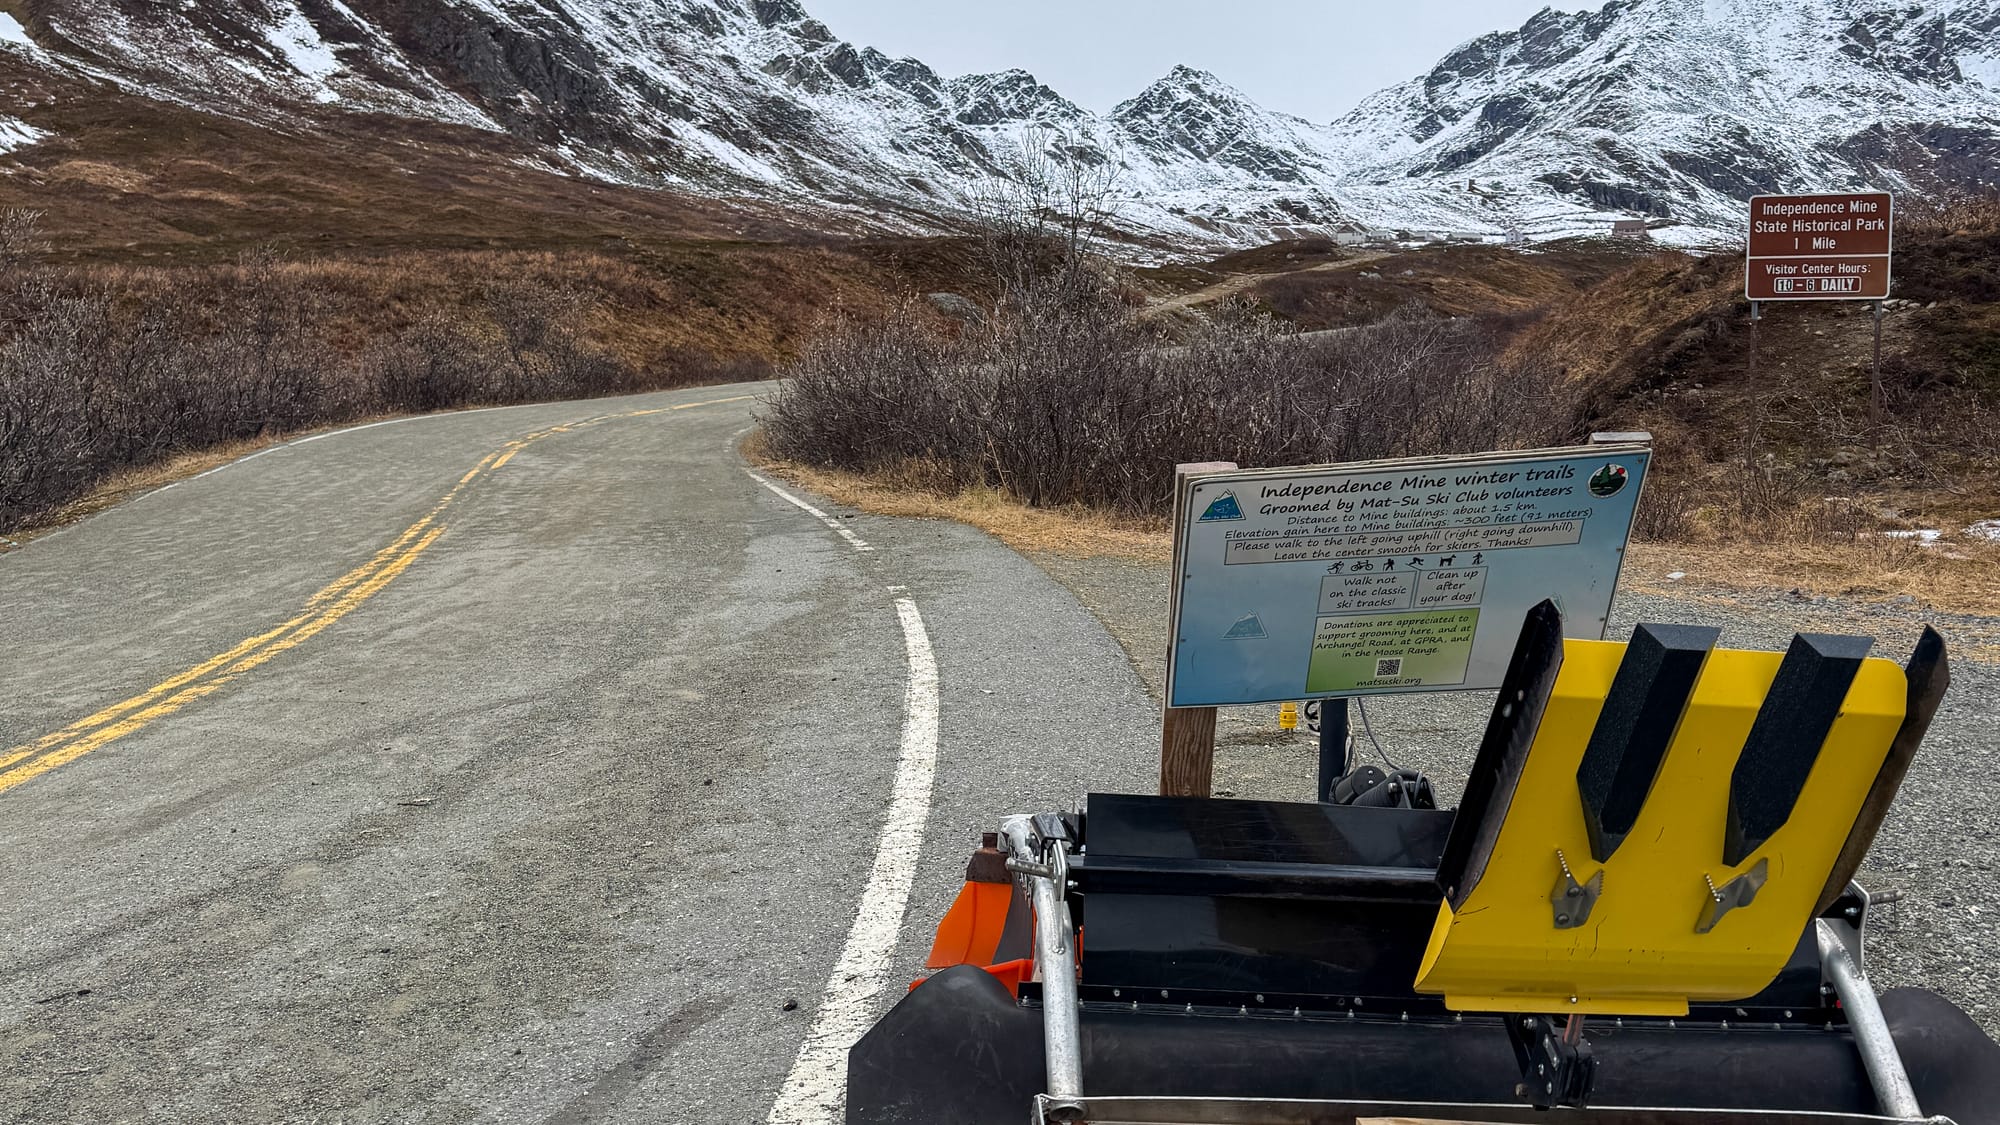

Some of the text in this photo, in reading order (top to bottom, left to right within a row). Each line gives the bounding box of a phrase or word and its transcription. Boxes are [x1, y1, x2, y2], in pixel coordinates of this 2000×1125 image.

[1763, 200, 1878, 217] Independence Mine
[1755, 218, 1884, 233] State Historical Park
[1794, 237, 1836, 250] 1 Mile
[1766, 264, 1871, 274] Visitor Center Hours:
[1822, 279, 1854, 290] DAILY
[1260, 464, 1575, 500] Independence Mine winter trails
[1260, 485, 1572, 515] Groomed by Mat-Su Ski Club volunteers
[1288, 502, 1538, 525] Distance to Mine buildings: about 1.5 km.
[1225, 529, 1278, 539] Elevation
[1283, 528, 1308, 538] gain
[1314, 526, 1340, 535] here
[1345, 524, 1357, 532] to
[1362, 522, 1390, 532] Mine
[1395, 519, 1450, 530] buildings:
[1494, 514, 1516, 523] feet
[1521, 512, 1542, 523] (91
[1548, 508, 1593, 519] meters)
[1234, 522, 1576, 550] Please walk to the left going uphill (right going downhill).
[1274, 537, 1532, 560] Leave the center smooth for skiers. Thanks!
[1344, 576, 1396, 586] Walk not
[1427, 571, 1478, 580] Clean up
[1372, 586, 1407, 595] classic
[1436, 582, 1465, 591] after
[1356, 598, 1395, 607] tracks!
[1420, 592, 1476, 604] your dog!
[1324, 621, 1373, 630] Donations
[1396, 616, 1455, 626] appreciated
[1317, 632, 1356, 640] support
[1360, 630, 1406, 640] grooming
[1438, 626, 1457, 634] and
[1315, 640, 1364, 650] Archangel
[1450, 635, 1470, 643] and
[1374, 648, 1403, 656] Moose
[1356, 677, 1422, 686] matsuski.org
